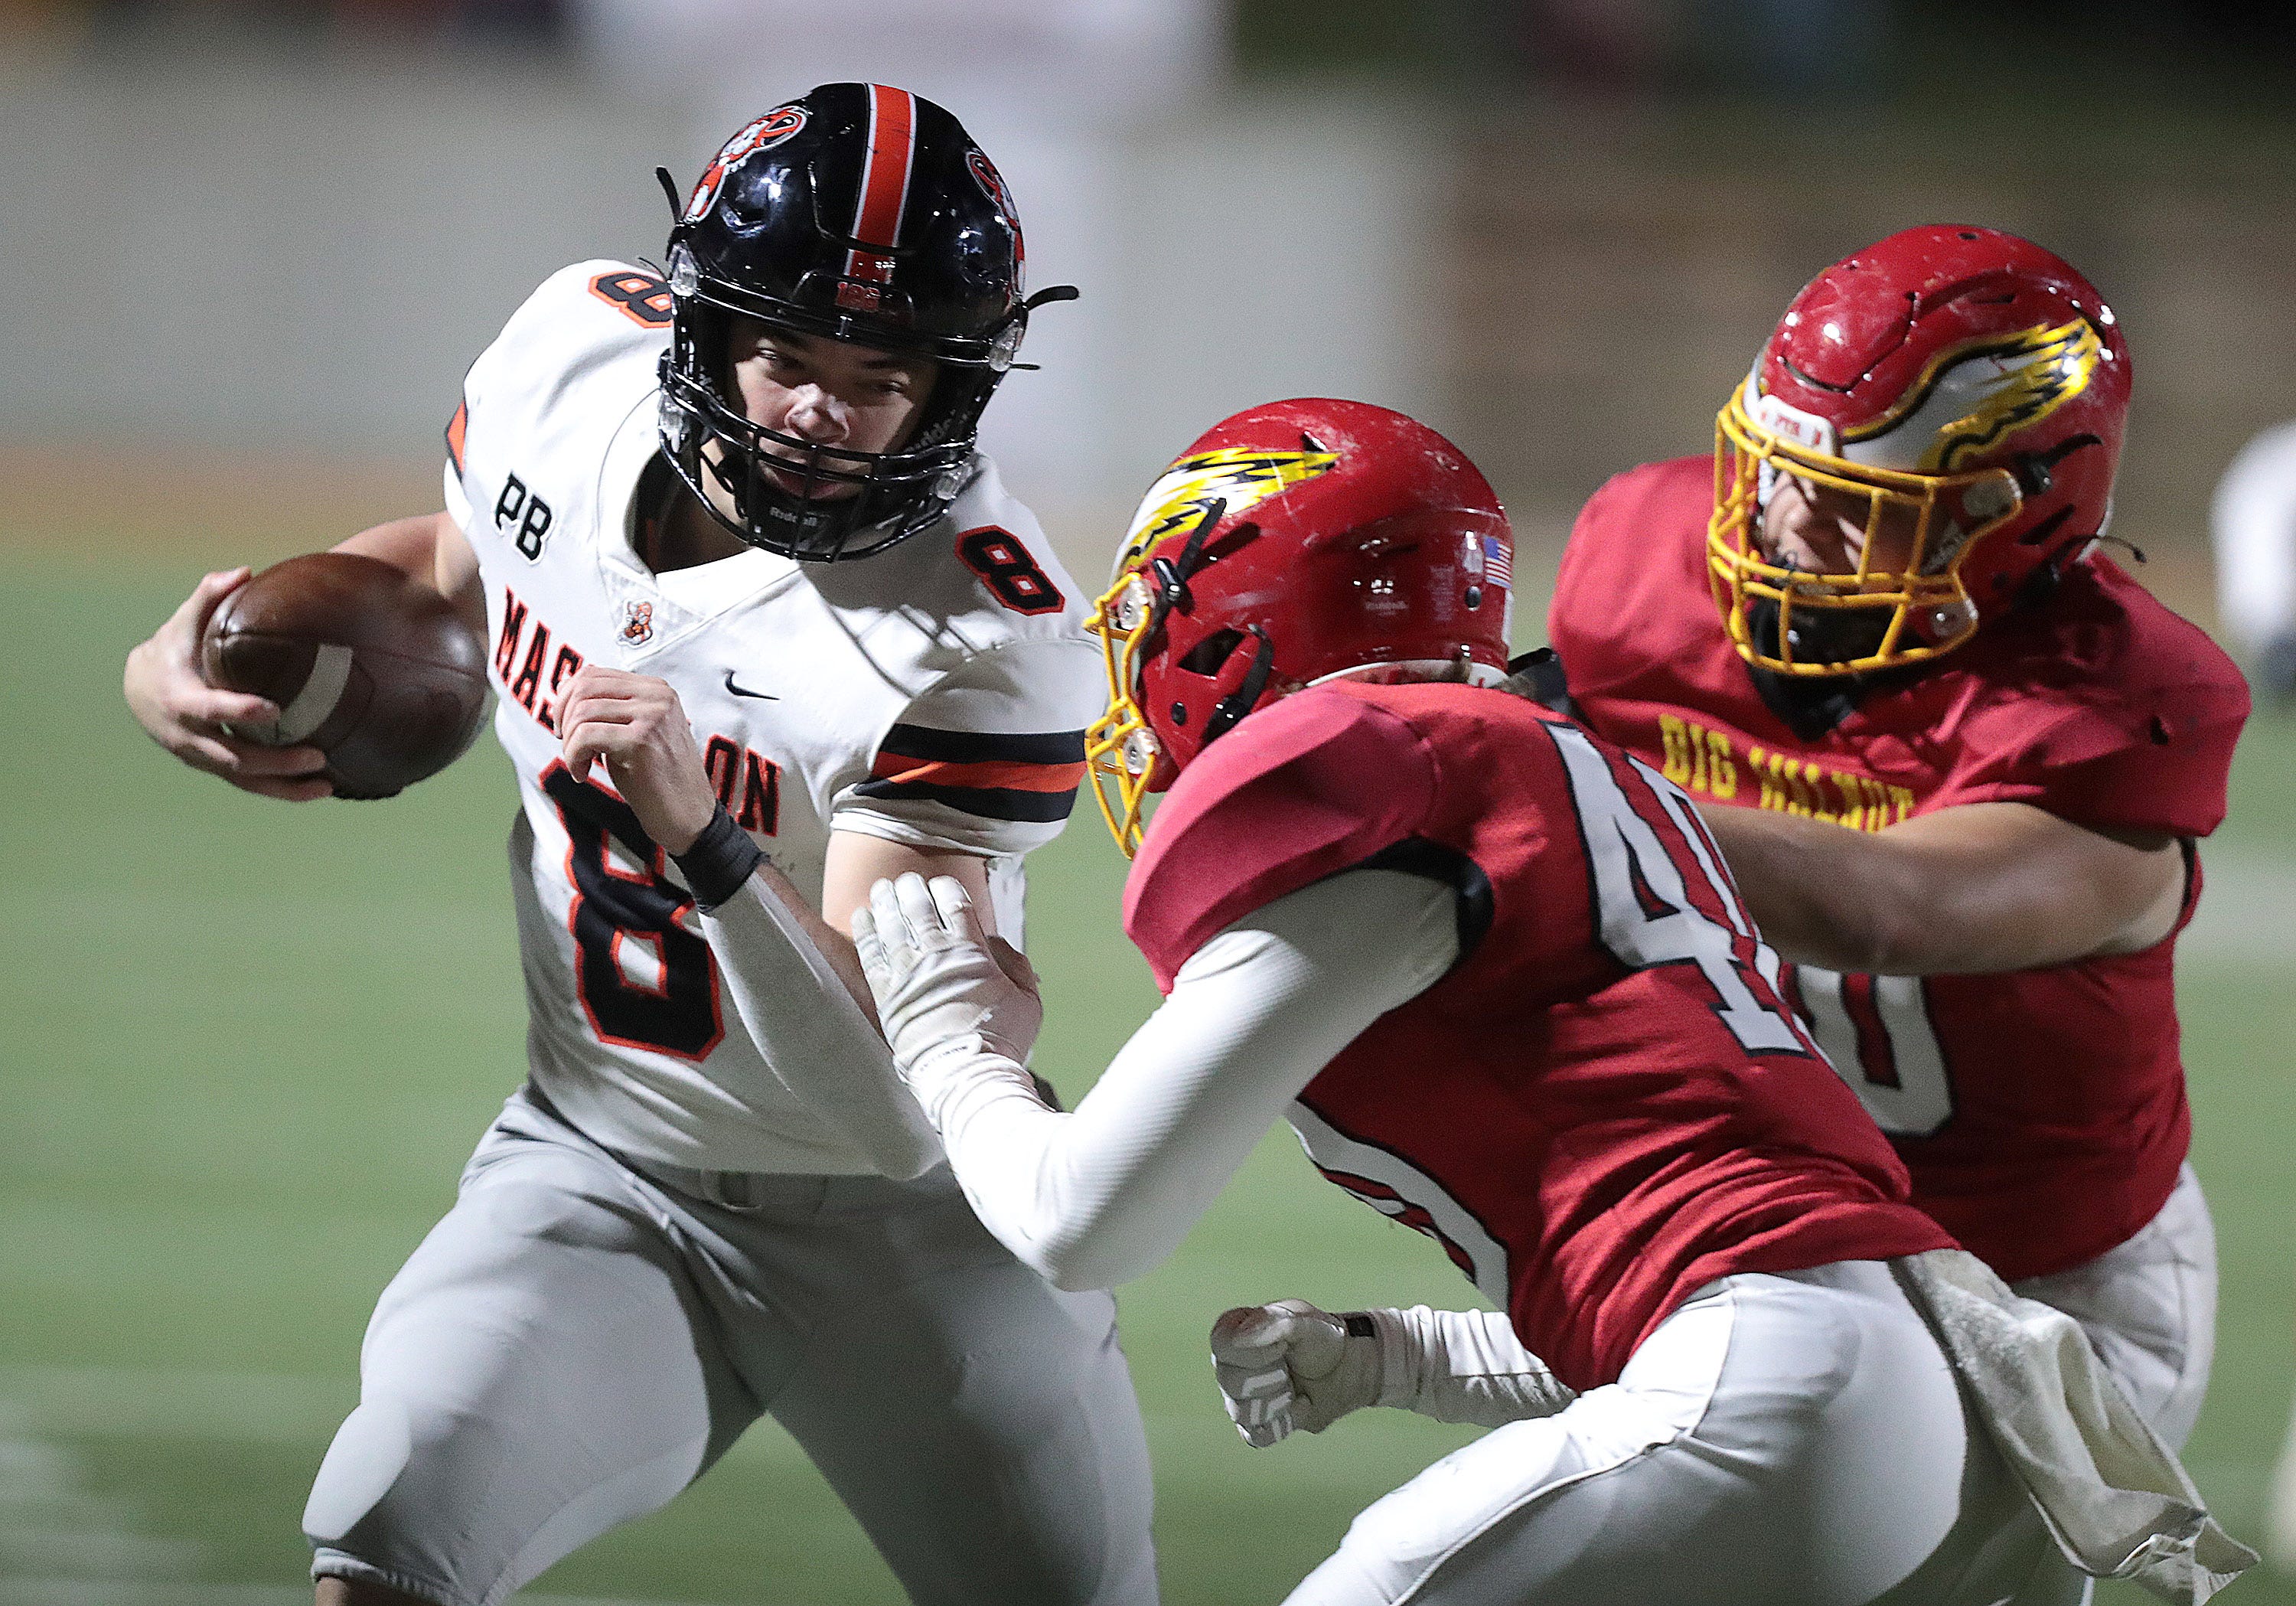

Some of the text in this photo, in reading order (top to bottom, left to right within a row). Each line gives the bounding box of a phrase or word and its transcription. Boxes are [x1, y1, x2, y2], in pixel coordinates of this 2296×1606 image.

[588, 270, 673, 328] 8
[494, 471, 553, 562] PB
[954, 524, 1065, 616] 8
[1659, 713, 1737, 799] BIG
[538, 756, 726, 1063] 8
